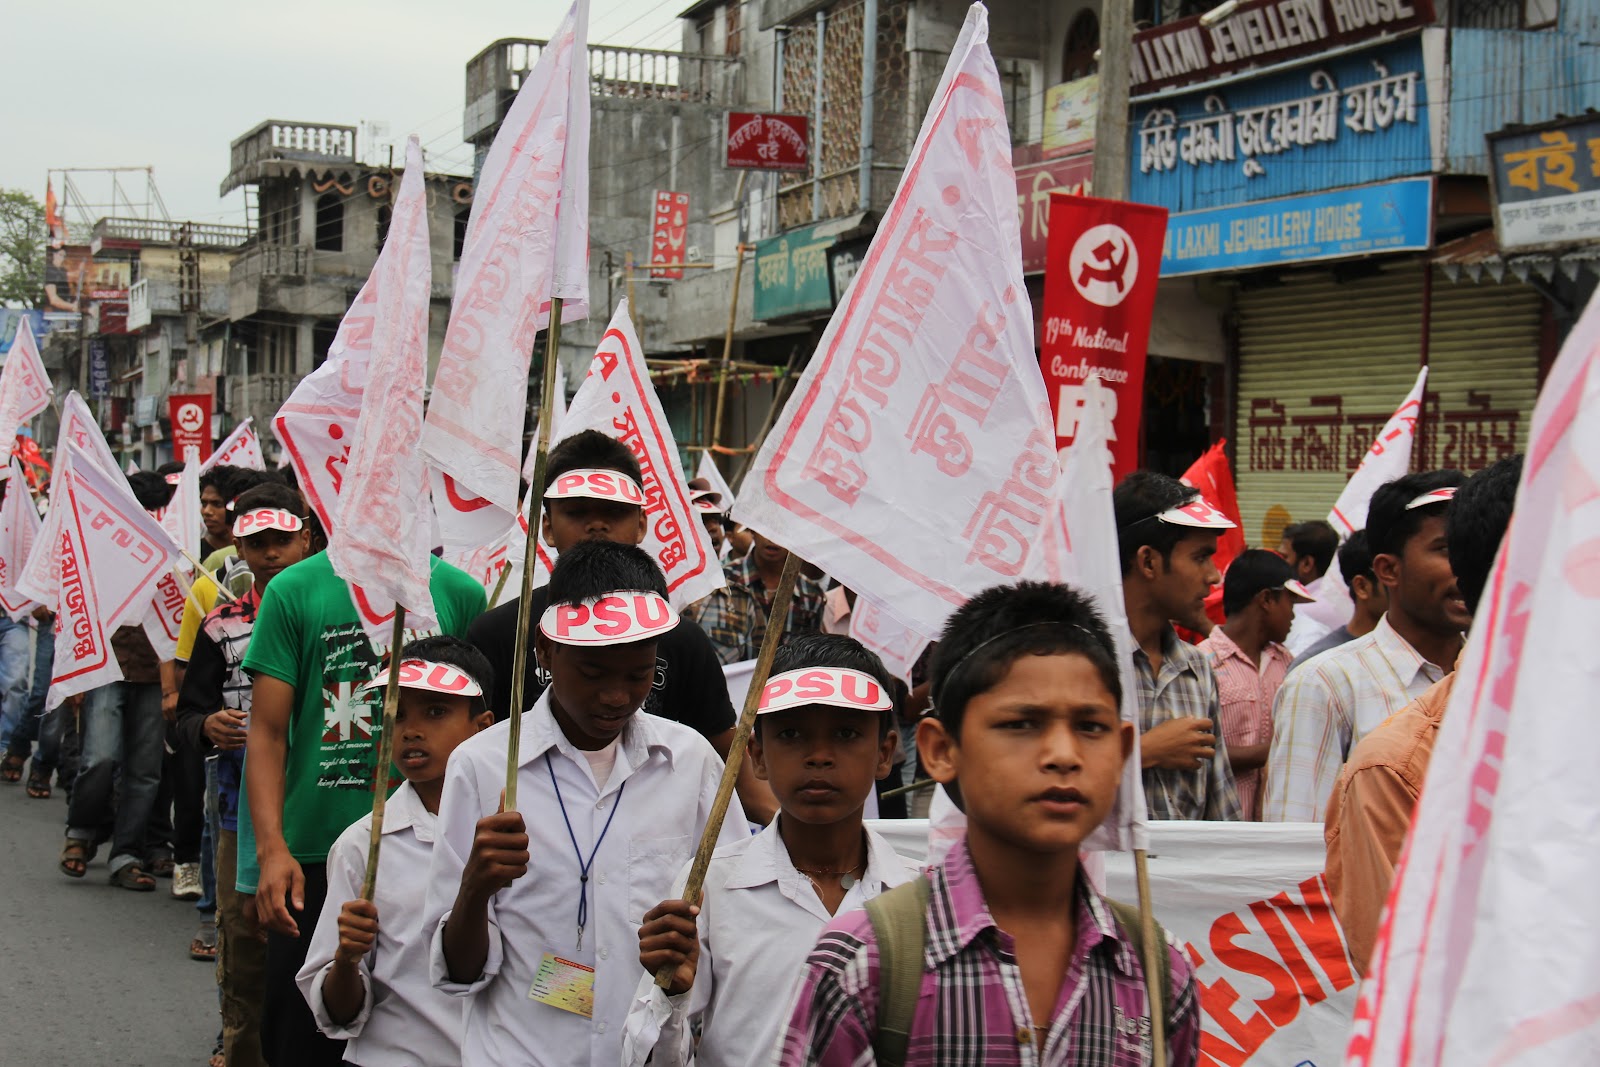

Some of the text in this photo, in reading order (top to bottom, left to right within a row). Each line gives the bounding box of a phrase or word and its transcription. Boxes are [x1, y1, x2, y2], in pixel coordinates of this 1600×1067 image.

[1142, 27, 1209, 79] LAXMI
[1211, 0, 1329, 64] JEWELLERY
[1333, 0, 1414, 32] HOUSE
[1503, 131, 1581, 193] বই
[652, 192, 671, 275] RUPAYAN
[1176, 217, 1220, 260] LAXMI
[1224, 207, 1312, 254] JEWELLERY
[1314, 202, 1362, 243] HOUSE
[1046, 317, 1130, 354] 19th National
[557, 473, 642, 502] PSU
[239, 510, 297, 533] PSU
[556, 596, 670, 637] PSU
[377, 659, 470, 692] SU
[759, 671, 880, 708] PSU
